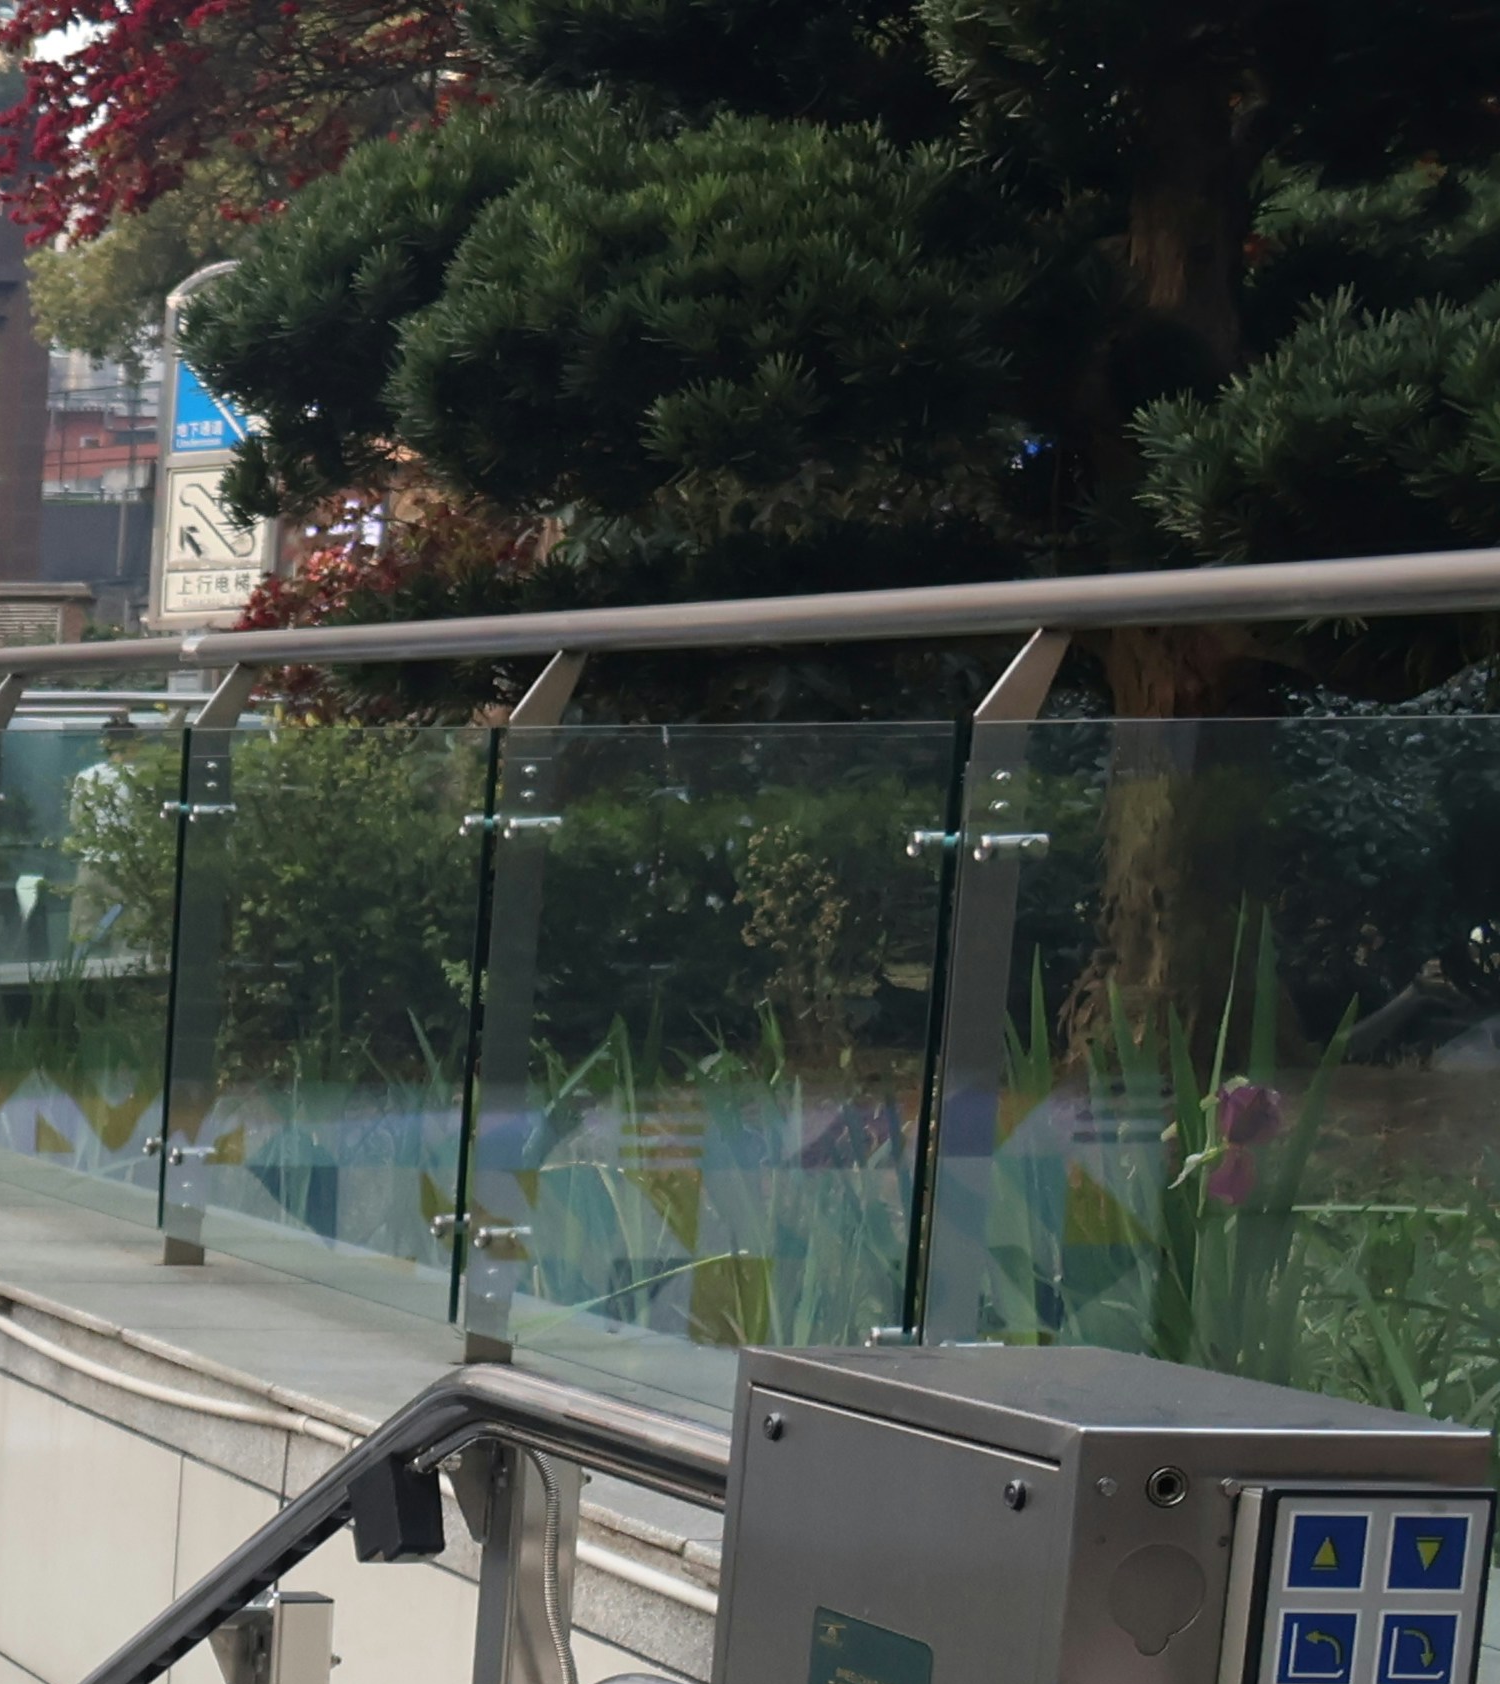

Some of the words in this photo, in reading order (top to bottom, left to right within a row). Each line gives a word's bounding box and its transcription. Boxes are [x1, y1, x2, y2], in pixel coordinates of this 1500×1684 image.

[175, 420, 223, 438] 地下通道
[176, 572, 251, 596] 上行电梯
